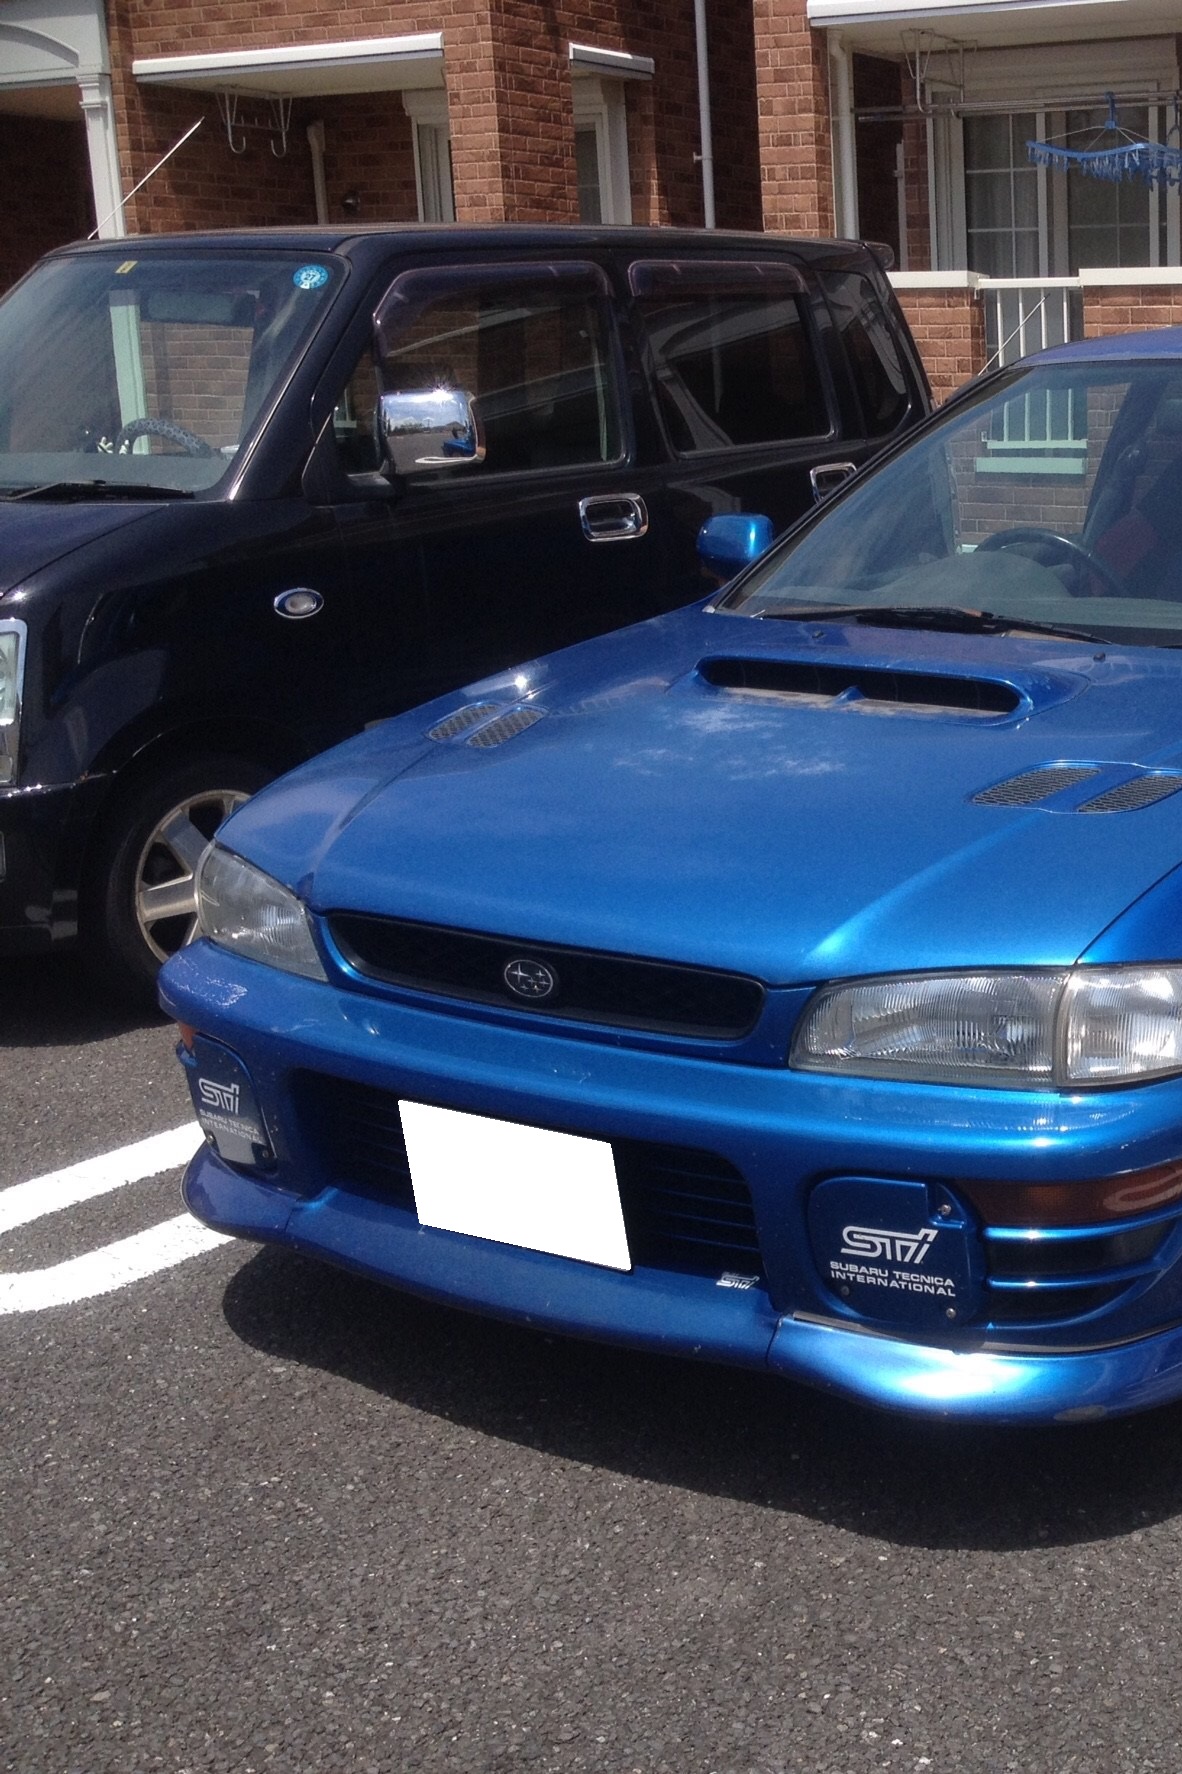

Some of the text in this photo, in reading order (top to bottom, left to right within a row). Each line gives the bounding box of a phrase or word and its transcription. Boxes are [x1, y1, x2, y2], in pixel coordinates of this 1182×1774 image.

[830, 1261, 955, 1288] SUBARU TECNICA
[830, 1270, 957, 1297] INTERNATIONAL
